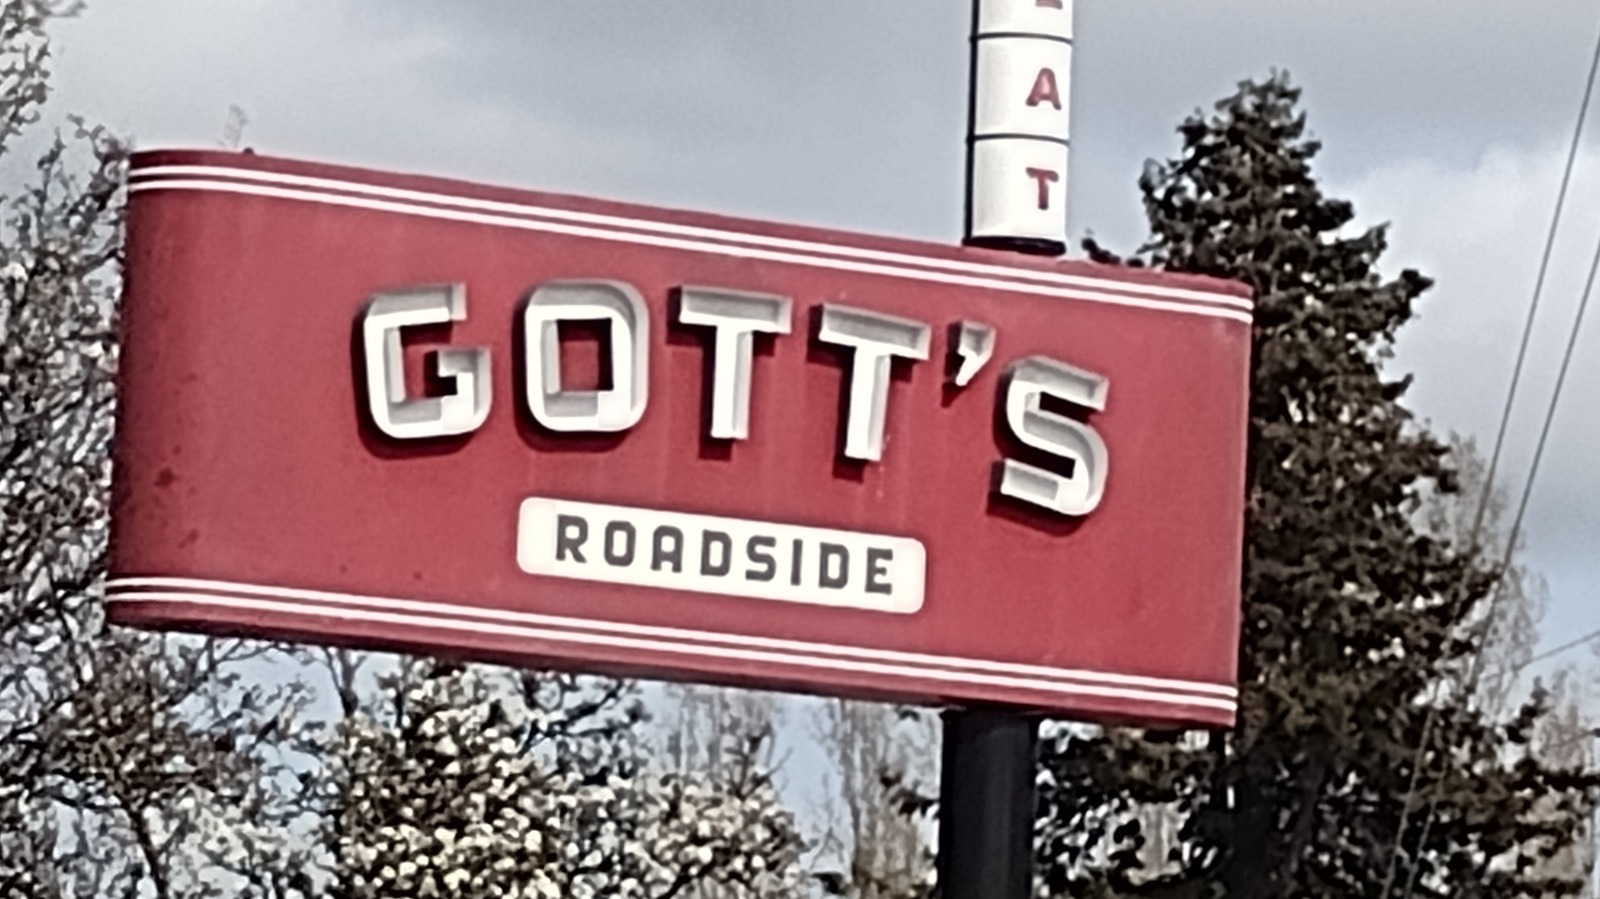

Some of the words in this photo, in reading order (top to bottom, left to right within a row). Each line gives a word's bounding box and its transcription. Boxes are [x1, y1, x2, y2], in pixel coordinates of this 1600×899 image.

[1025, 0, 1063, 211] AT
[363, 279, 1110, 517] GOTT'S
[555, 514, 894, 595] ROADSIDE
